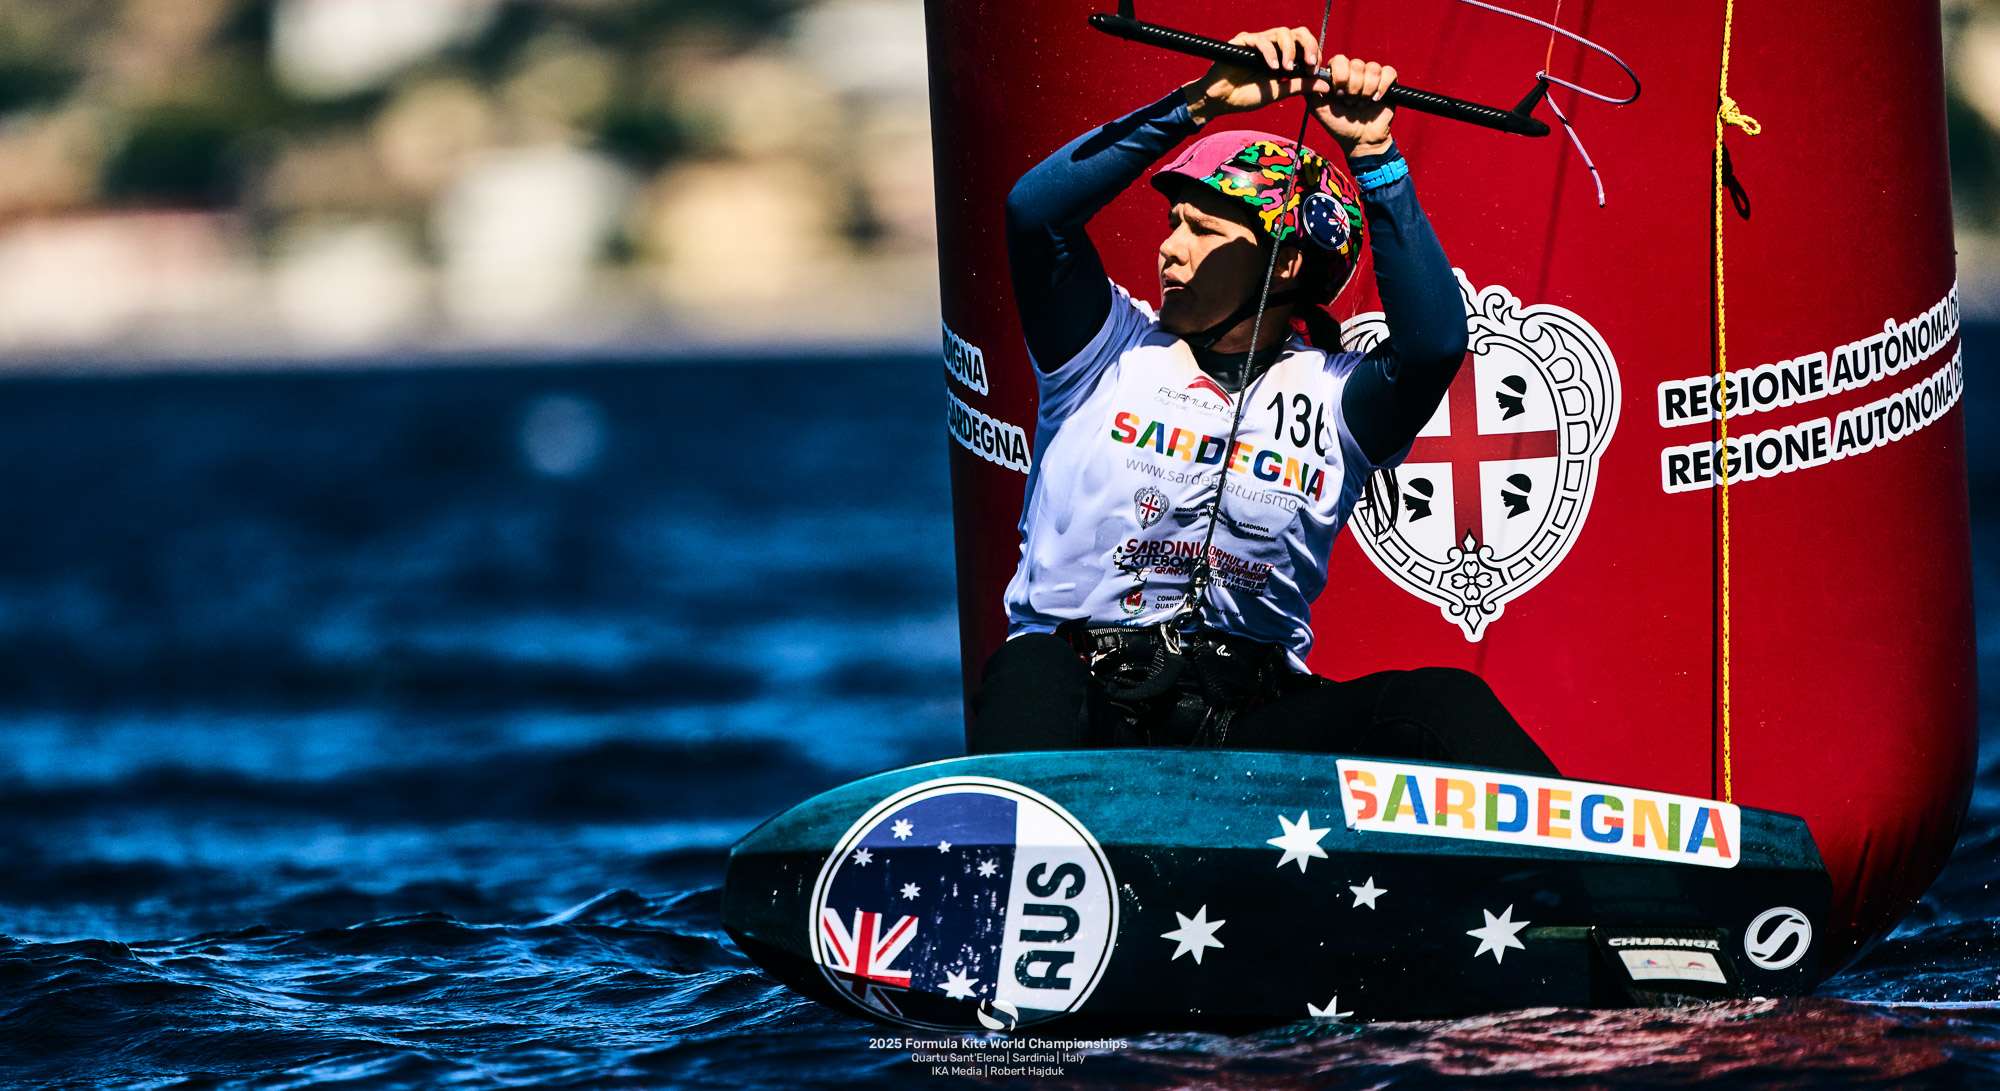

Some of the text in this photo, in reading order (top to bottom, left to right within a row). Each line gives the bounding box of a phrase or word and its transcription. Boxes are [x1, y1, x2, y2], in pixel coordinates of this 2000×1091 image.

[1158, 386, 1224, 413] FORMULA
[1664, 360, 1824, 421] REGIONE
[1833, 312, 1949, 387] AUTÒNOMA
[1111, 411, 1326, 503] SARDEGNA
[1267, 391, 1331, 458] 136
[1668, 425, 1827, 486] REGIONE
[1836, 372, 1952, 453] AUTONOMA
[1125, 538, 1202, 559] SARDINI
[1206, 545, 1275, 573] ORMULA KITE
[1343, 769, 1732, 859] SARDEGNA
[1014, 862, 1086, 990] AUS
[1608, 937, 1721, 950] CHUBANGA
